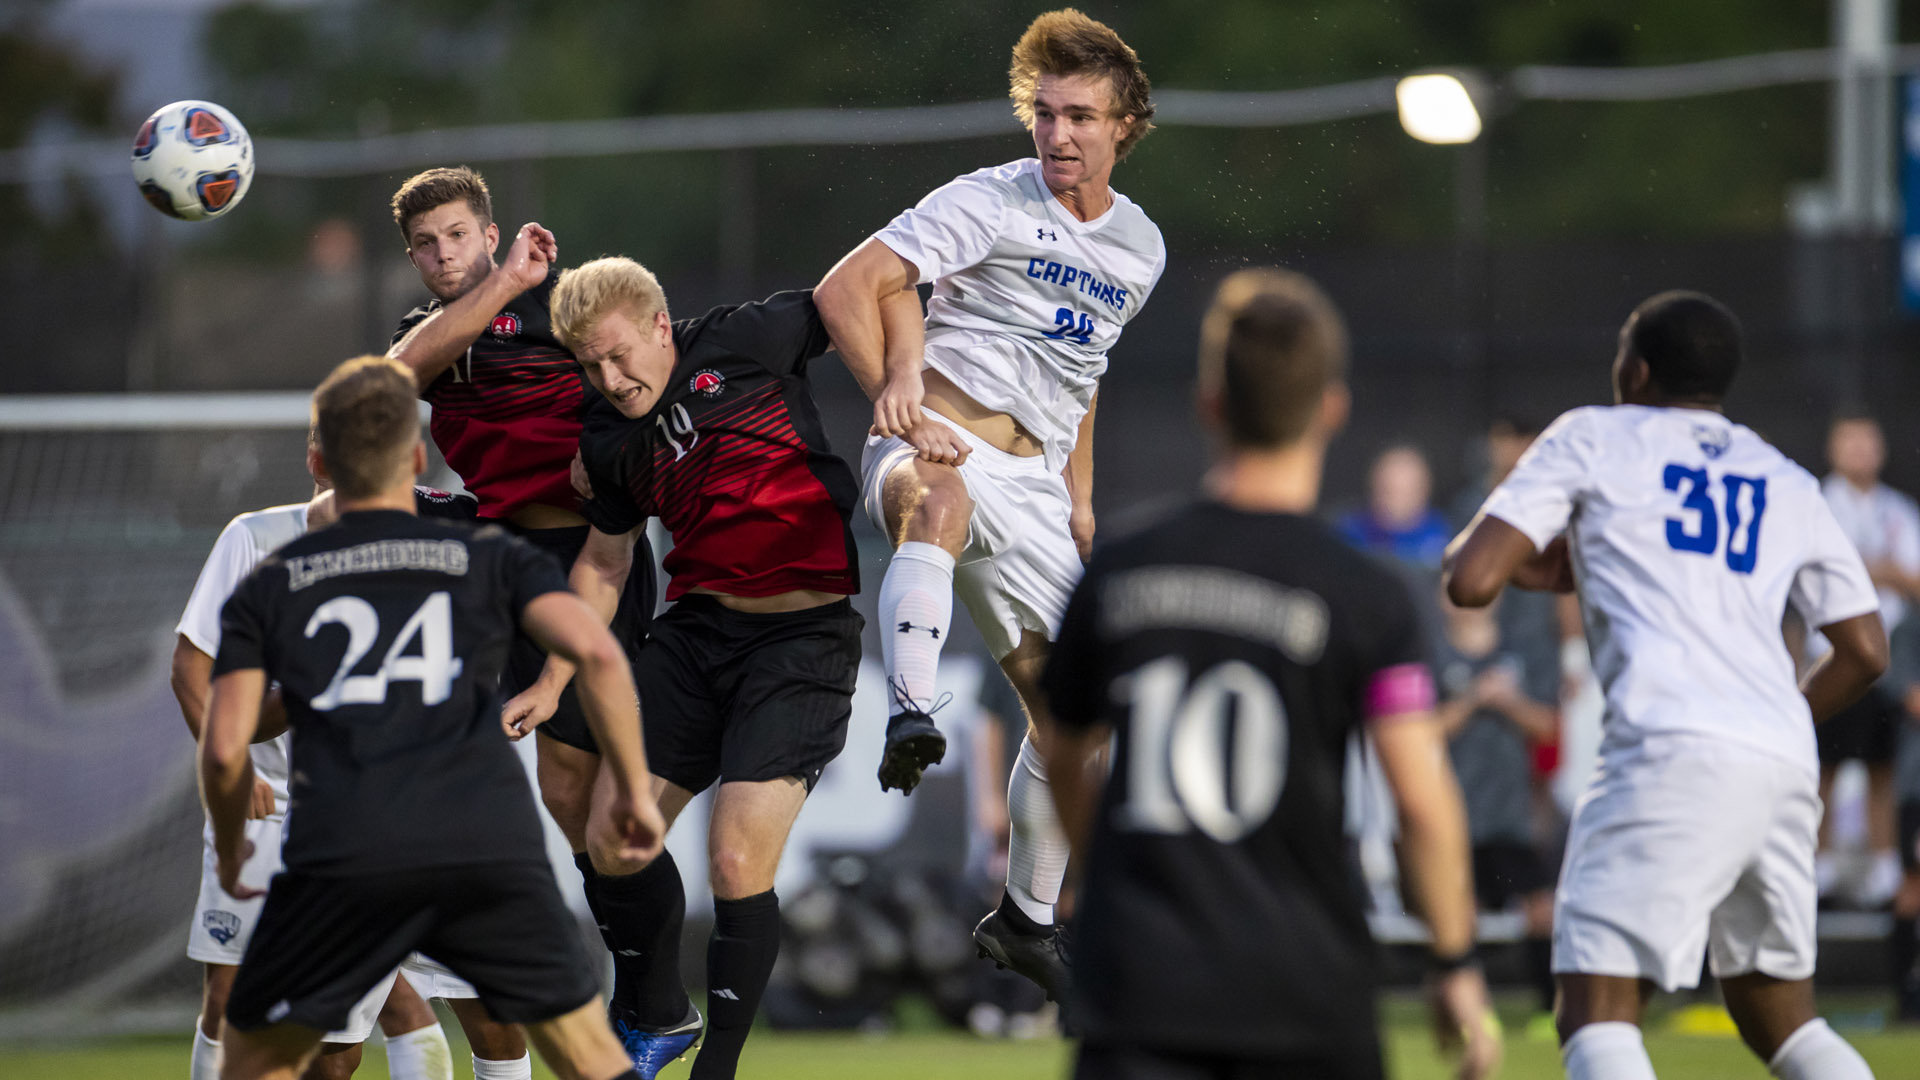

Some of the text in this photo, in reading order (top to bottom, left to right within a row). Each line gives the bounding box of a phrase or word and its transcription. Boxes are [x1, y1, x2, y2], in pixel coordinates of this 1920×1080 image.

[656, 402, 699, 462] 19
[1663, 463, 1767, 574] 30
[304, 591, 463, 710] 24
[1107, 654, 1290, 844] 10
